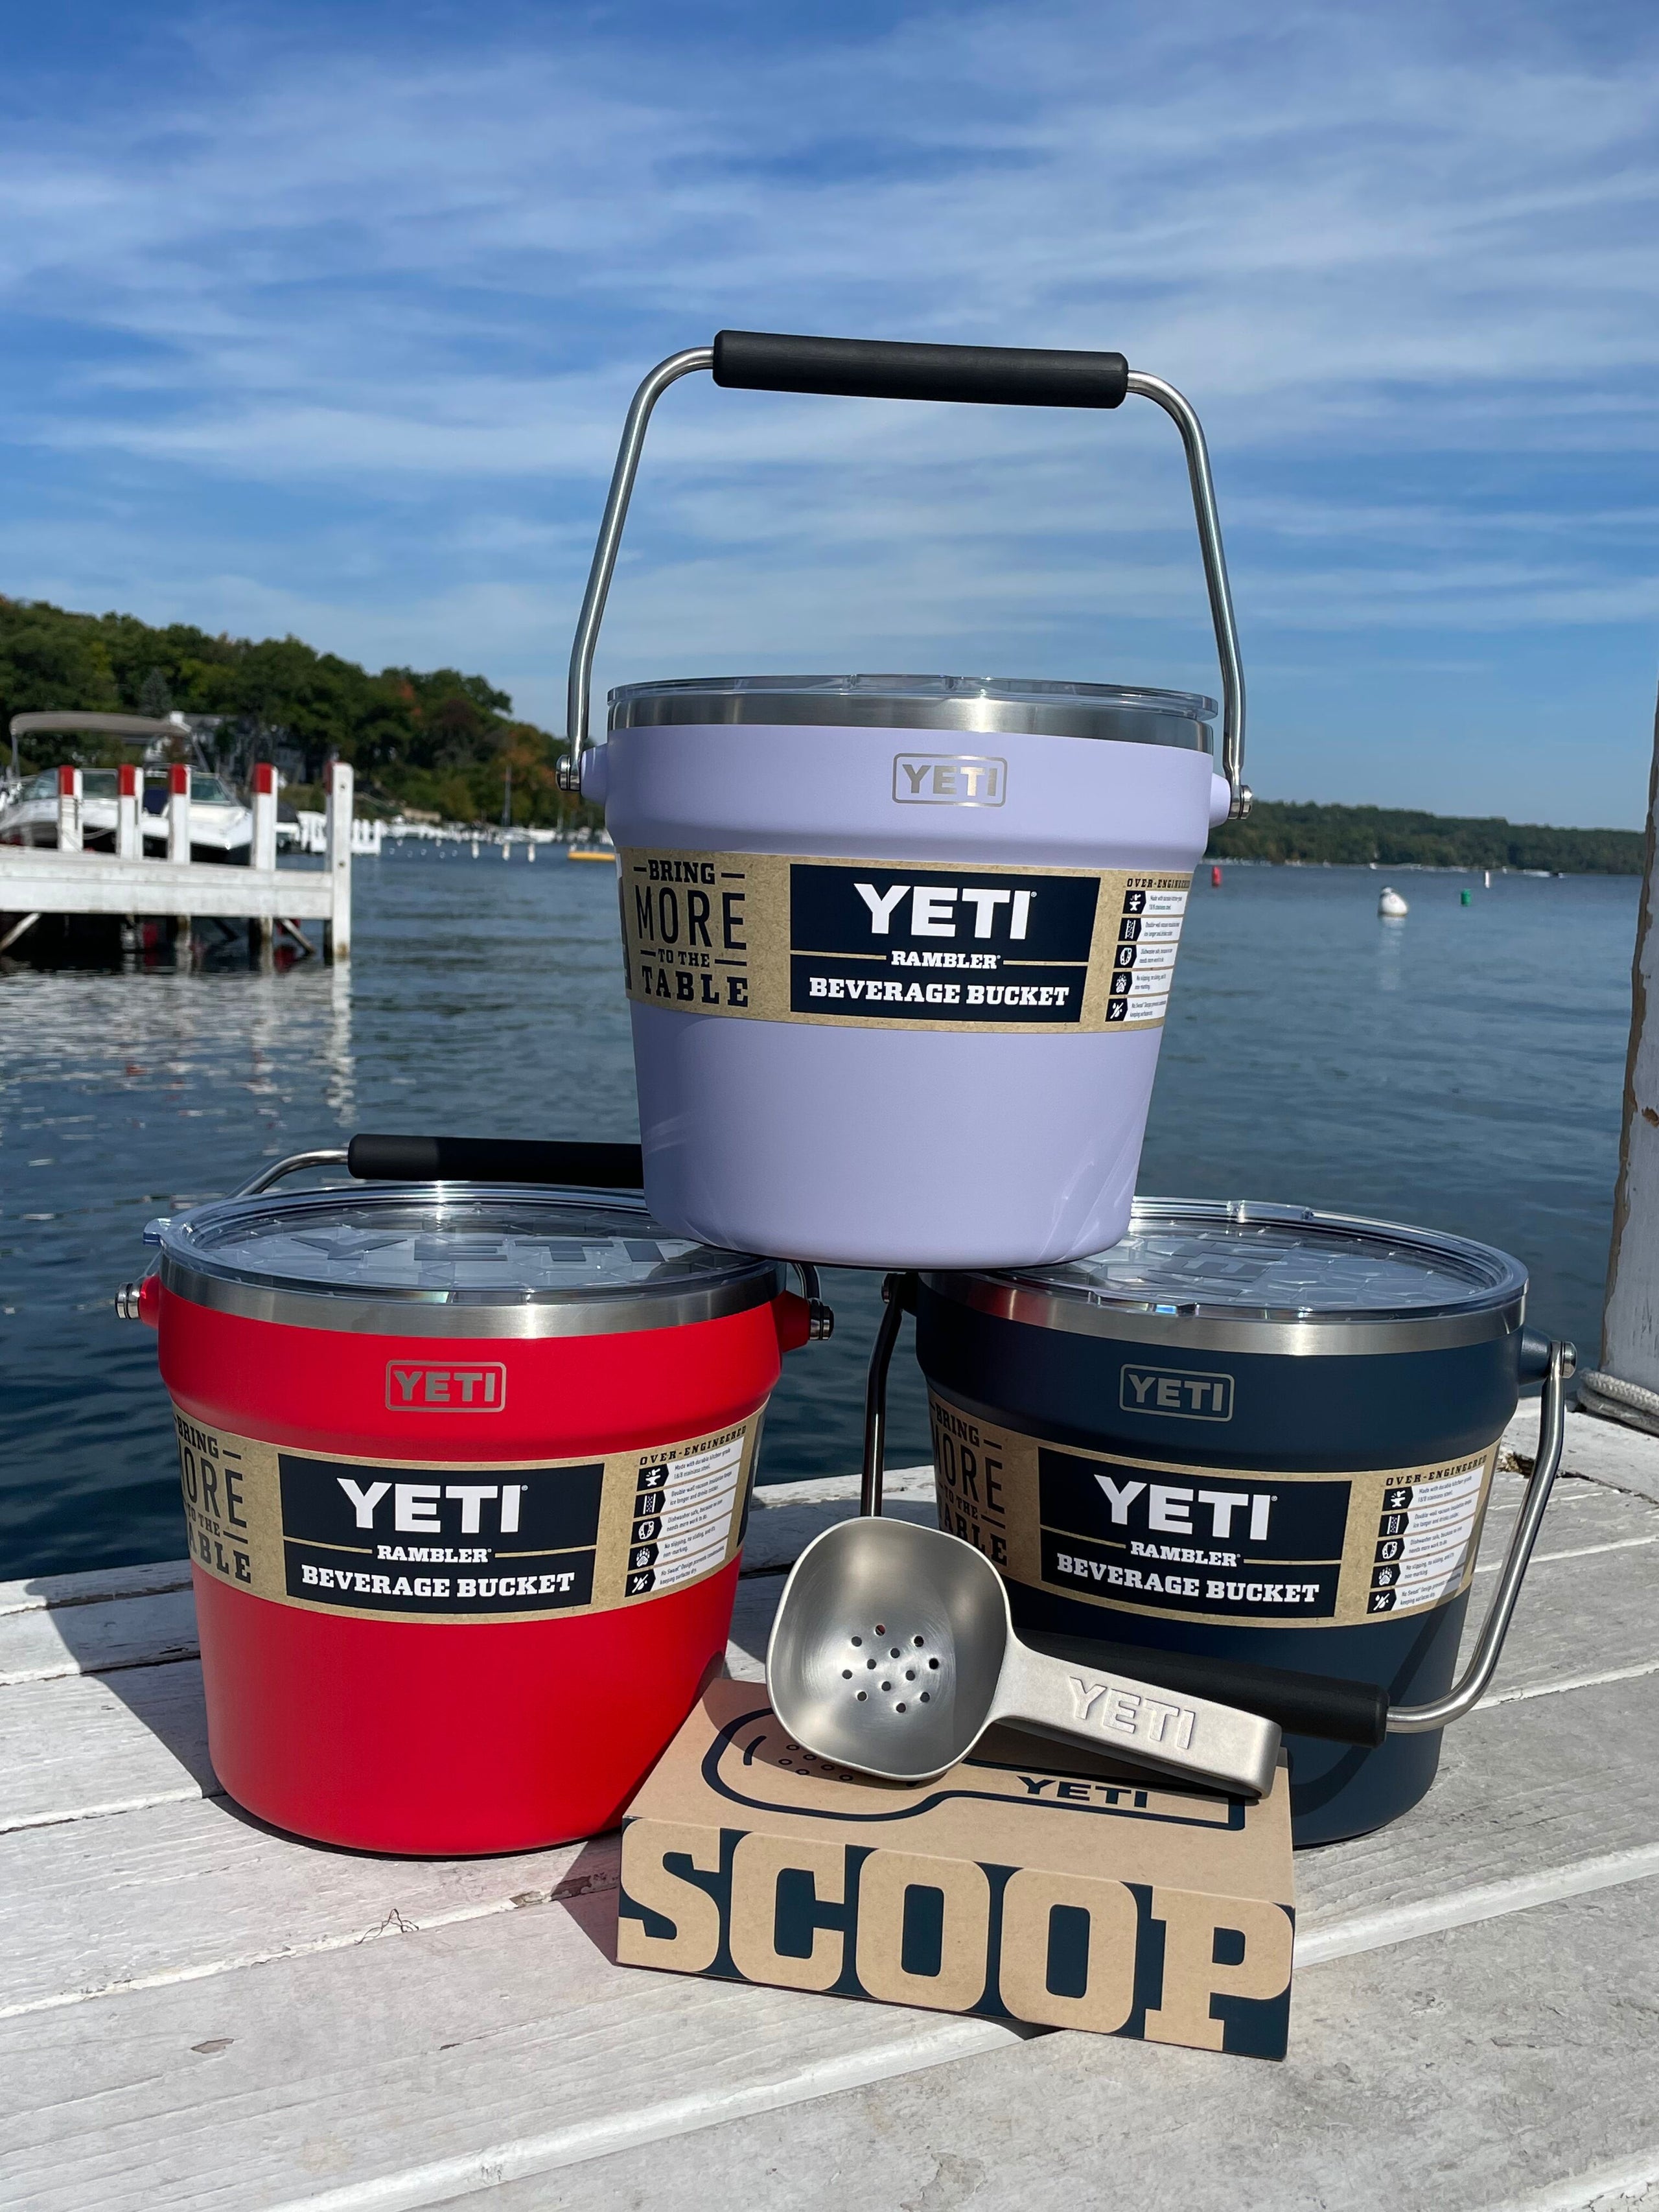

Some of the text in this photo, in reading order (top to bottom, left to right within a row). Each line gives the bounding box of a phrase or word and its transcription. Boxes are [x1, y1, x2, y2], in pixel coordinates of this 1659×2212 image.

[902, 764, 997, 797] YETI
[648, 859, 715, 885] BRING
[634, 885, 747, 950] MORE
[658, 948, 710, 968] TO THE
[642, 965, 748, 1007] TABLE
[809, 977, 1069, 1007] BEVERAGE BUCKET
[290, 1239, 666, 1262] YETI
[393, 1370, 496, 1402] YETI
[1128, 1373, 1224, 1411] YETI
[176, 1414, 219, 1459] BRING
[934, 1401, 980, 1447] BRING
[640, 1425, 746, 1465] OVER-ENGINEERED
[1386, 1454, 1487, 1486] OVER-ENGINEERED
[198, 1512, 220, 1537] THE
[956, 1495, 978, 1520] THE
[188, 1522, 251, 1583] ABLE
[301, 1564, 575, 1598] BEVERAGE BUCKET
[1057, 1553, 1319, 1602] BEVERAGE BUCKET
[1069, 1676, 1196, 1750] YETI
[1016, 1775, 1148, 1808] YETI
[617, 1817, 1293, 2051] SCOOP
